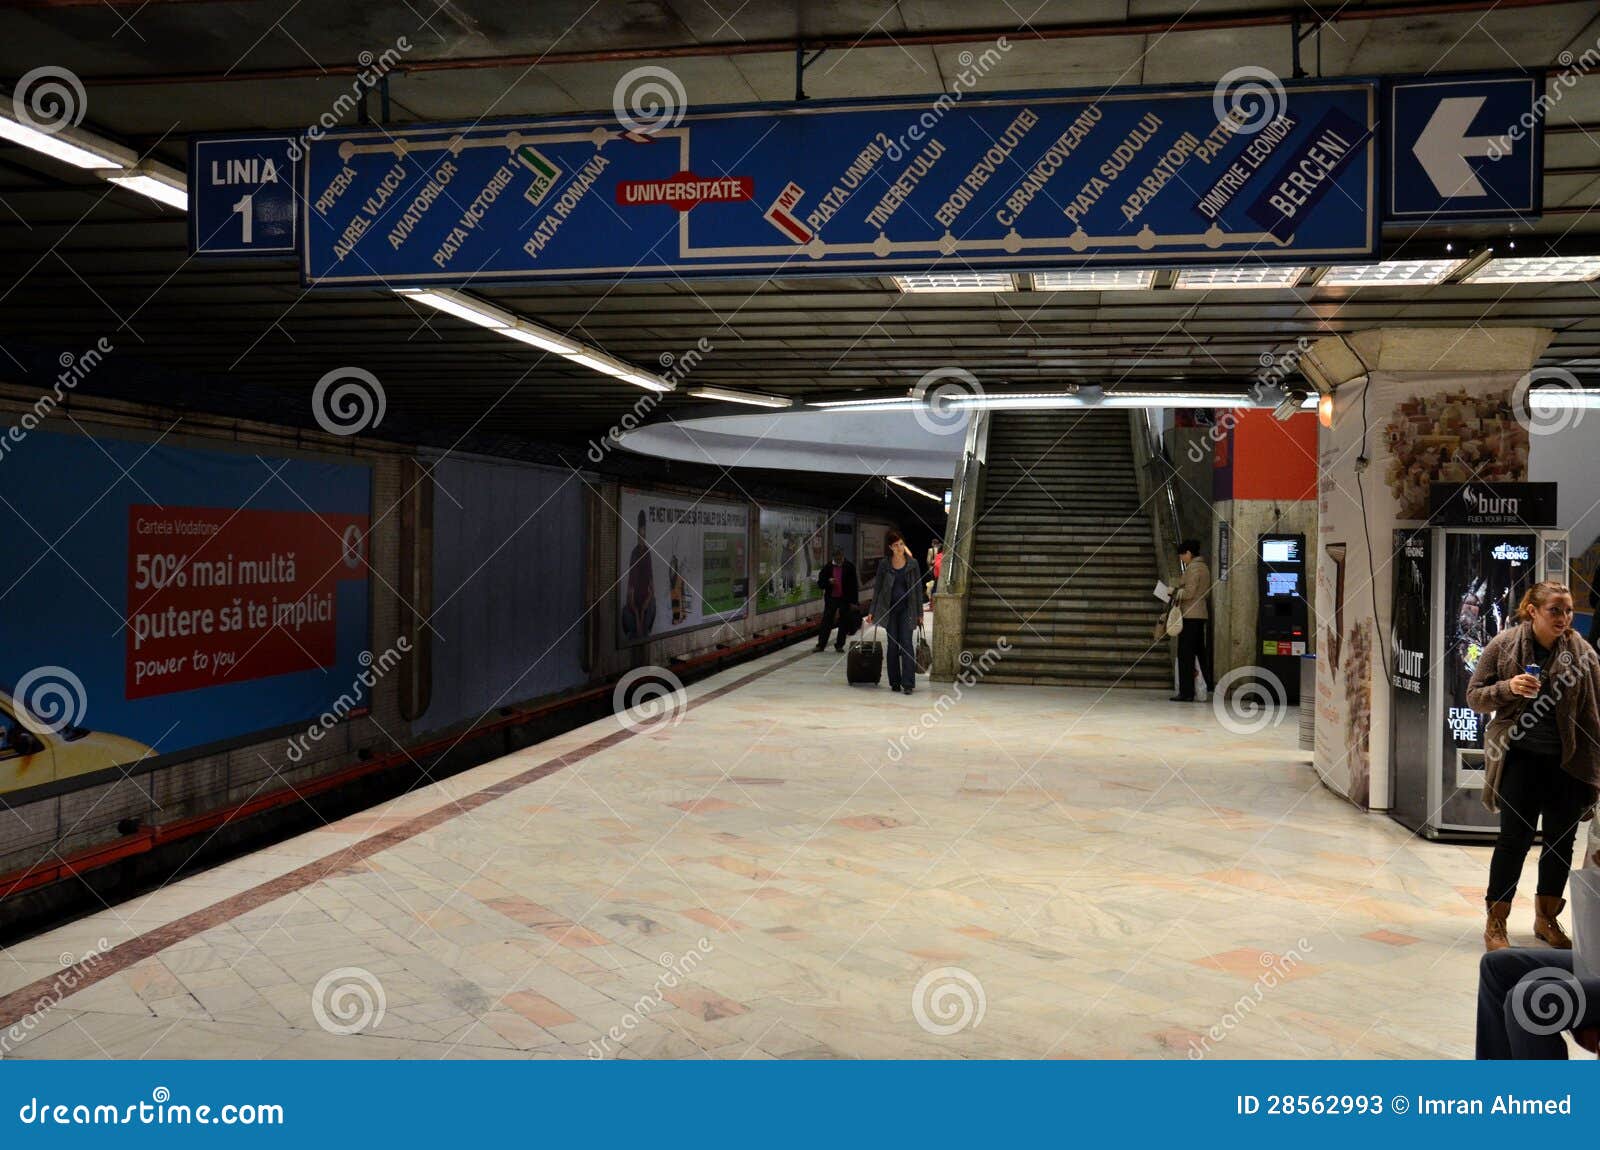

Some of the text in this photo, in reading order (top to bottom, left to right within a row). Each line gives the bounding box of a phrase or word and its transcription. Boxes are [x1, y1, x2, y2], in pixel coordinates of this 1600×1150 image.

[211, 159, 278, 186] LINIA
[527, 176, 550, 201] M3
[806, 132, 892, 231] PIATA UNIRII 2
[864, 138, 946, 229] TINERETULUI
[934, 108, 1040, 228] EROII REVOLUTIEI
[996, 104, 1103, 226] C.BRANCOVEANU
[1063, 112, 1163, 224] PIATA SUDULUI
[1119, 131, 1201, 222] APARATORII
[1198, 114, 1296, 218] DIMITRIE LEONIDA
[1269, 129, 1351, 219] BERCENI
[315, 166, 357, 216] PIPERA
[333, 163, 407, 261] AUREL VLAICU
[387, 161, 459, 251] AVIATORILOR
[523, 154, 610, 258] PIATA ROMANA
[626, 181, 741, 203] UNIVERSITATE
[232, 195, 253, 243] 1
[432, 227, 469, 268] PIATA
[459, 165, 514, 230] VICTORIEI
[174, 519, 220, 536] Vodafone
[1478, 492, 1519, 514] burn
[1503, 516, 1518, 524] FIRE
[135, 551, 296, 590] 50% mai multă
[1491, 551, 1529, 561] VENDING
[134, 592, 333, 650] putere să te implici
[135, 648, 236, 686] power to you
[1447, 718, 1478, 731] YOUR
[1449, 707, 1478, 720] FUEL
[1453, 730, 1478, 741] FIRE
